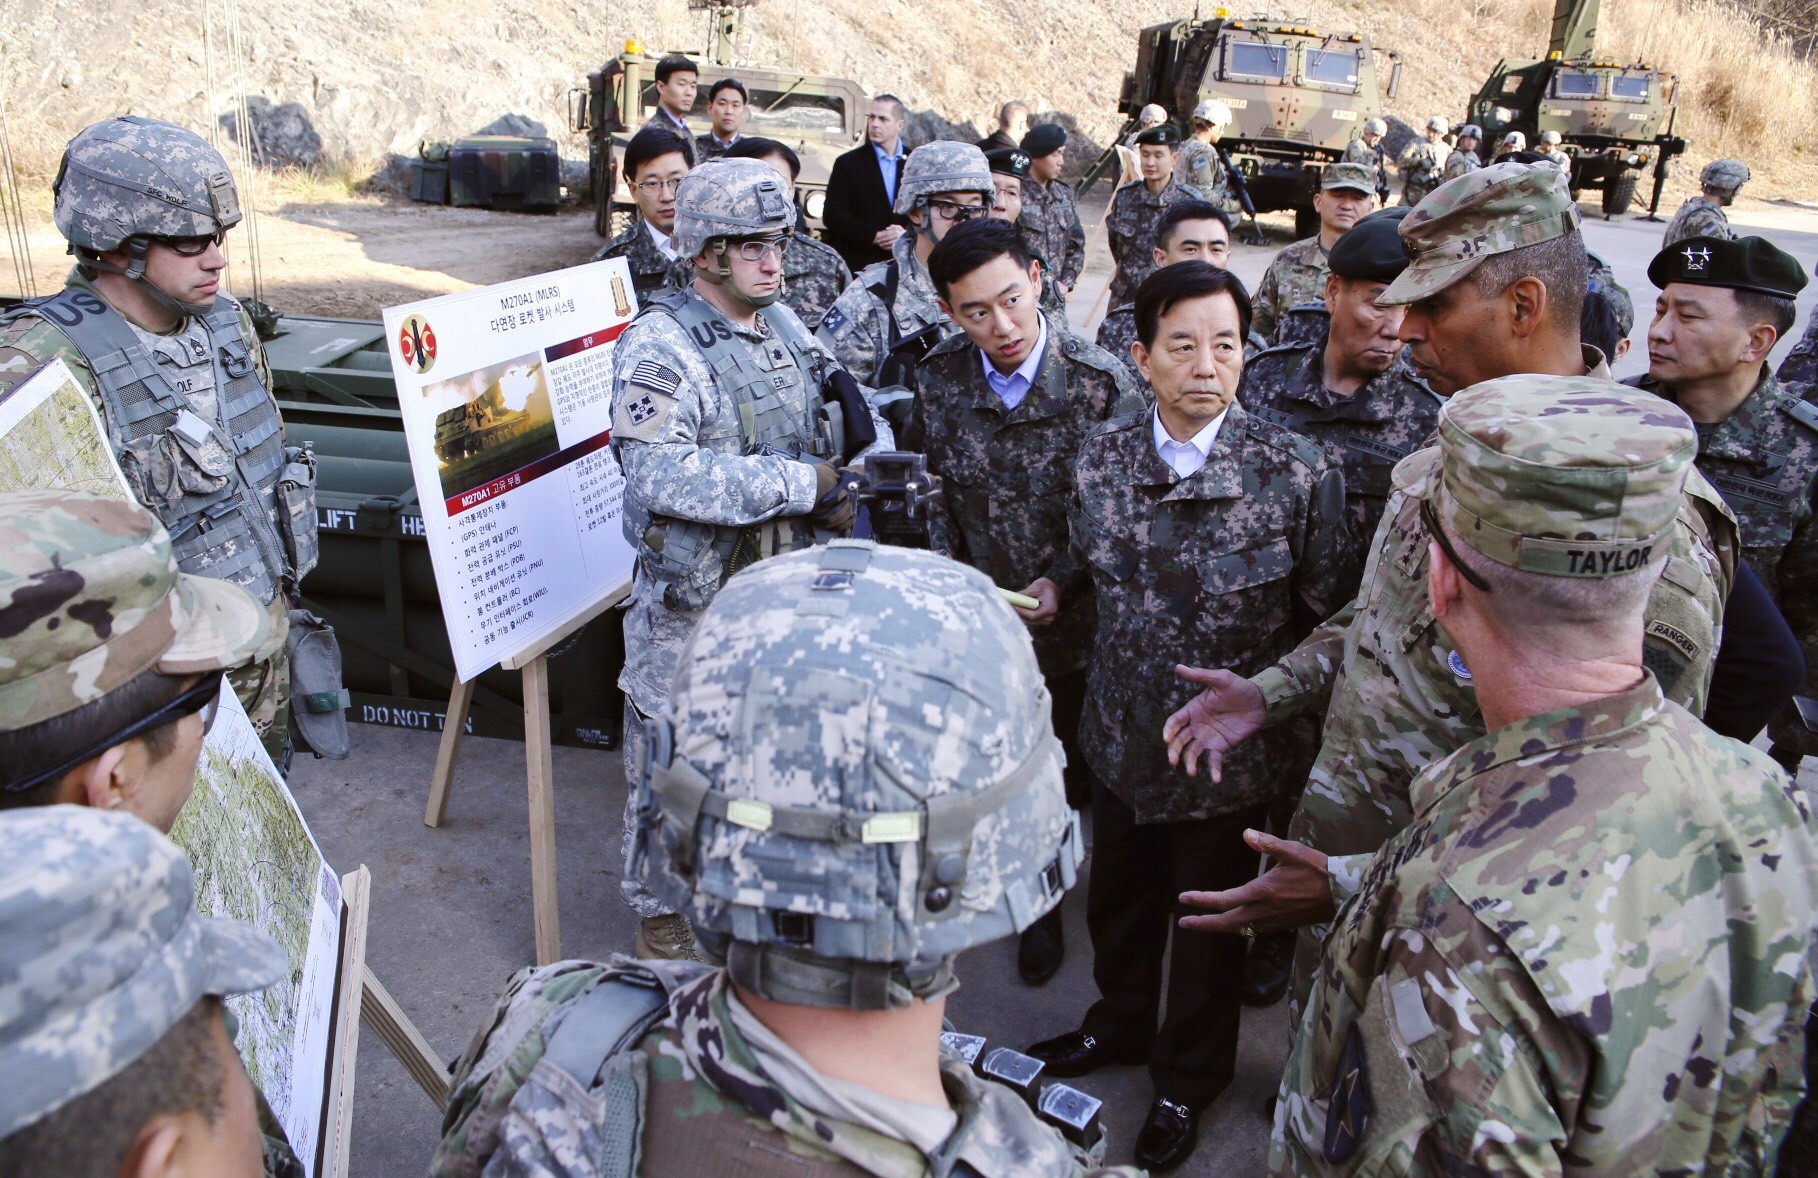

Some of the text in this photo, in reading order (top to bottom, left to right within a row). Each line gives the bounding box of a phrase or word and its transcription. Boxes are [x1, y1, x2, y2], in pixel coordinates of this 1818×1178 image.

[147, 187, 187, 206] SFC WOLF
[42, 293, 107, 327] US
[500, 286, 561, 310] M270A1 (MLRS)
[490, 298, 575, 333] 다연장 로켓 발사 시스템
[691, 319, 732, 348] US
[177, 378, 193, 392] OLF
[774, 376, 785, 387] ER
[461, 473, 521, 507] M270A1 고유 부품
[316, 508, 427, 536] LIFT HE
[458, 506, 494, 527] 사격통제장치
[461, 520, 497, 543] (GPS) 안테나
[464, 546, 478, 558] 화력
[504, 526, 519, 538] (FCP)
[468, 540, 522, 572] 전력 공급 유닛 (PSU)
[1567, 545, 1653, 575] TAYLOR
[471, 574, 484, 587] 전력
[474, 589, 486, 602] 위치
[517, 566, 528, 580] 유닛
[528, 558, 544, 572] (PNU)
[510, 586, 521, 599] (BC)
[480, 618, 493, 630] 무기
[484, 632, 496, 645] 공동
[1653, 624, 1695, 654] RANGER
[363, 705, 389, 723] DO
[393, 708, 431, 728] NOT
